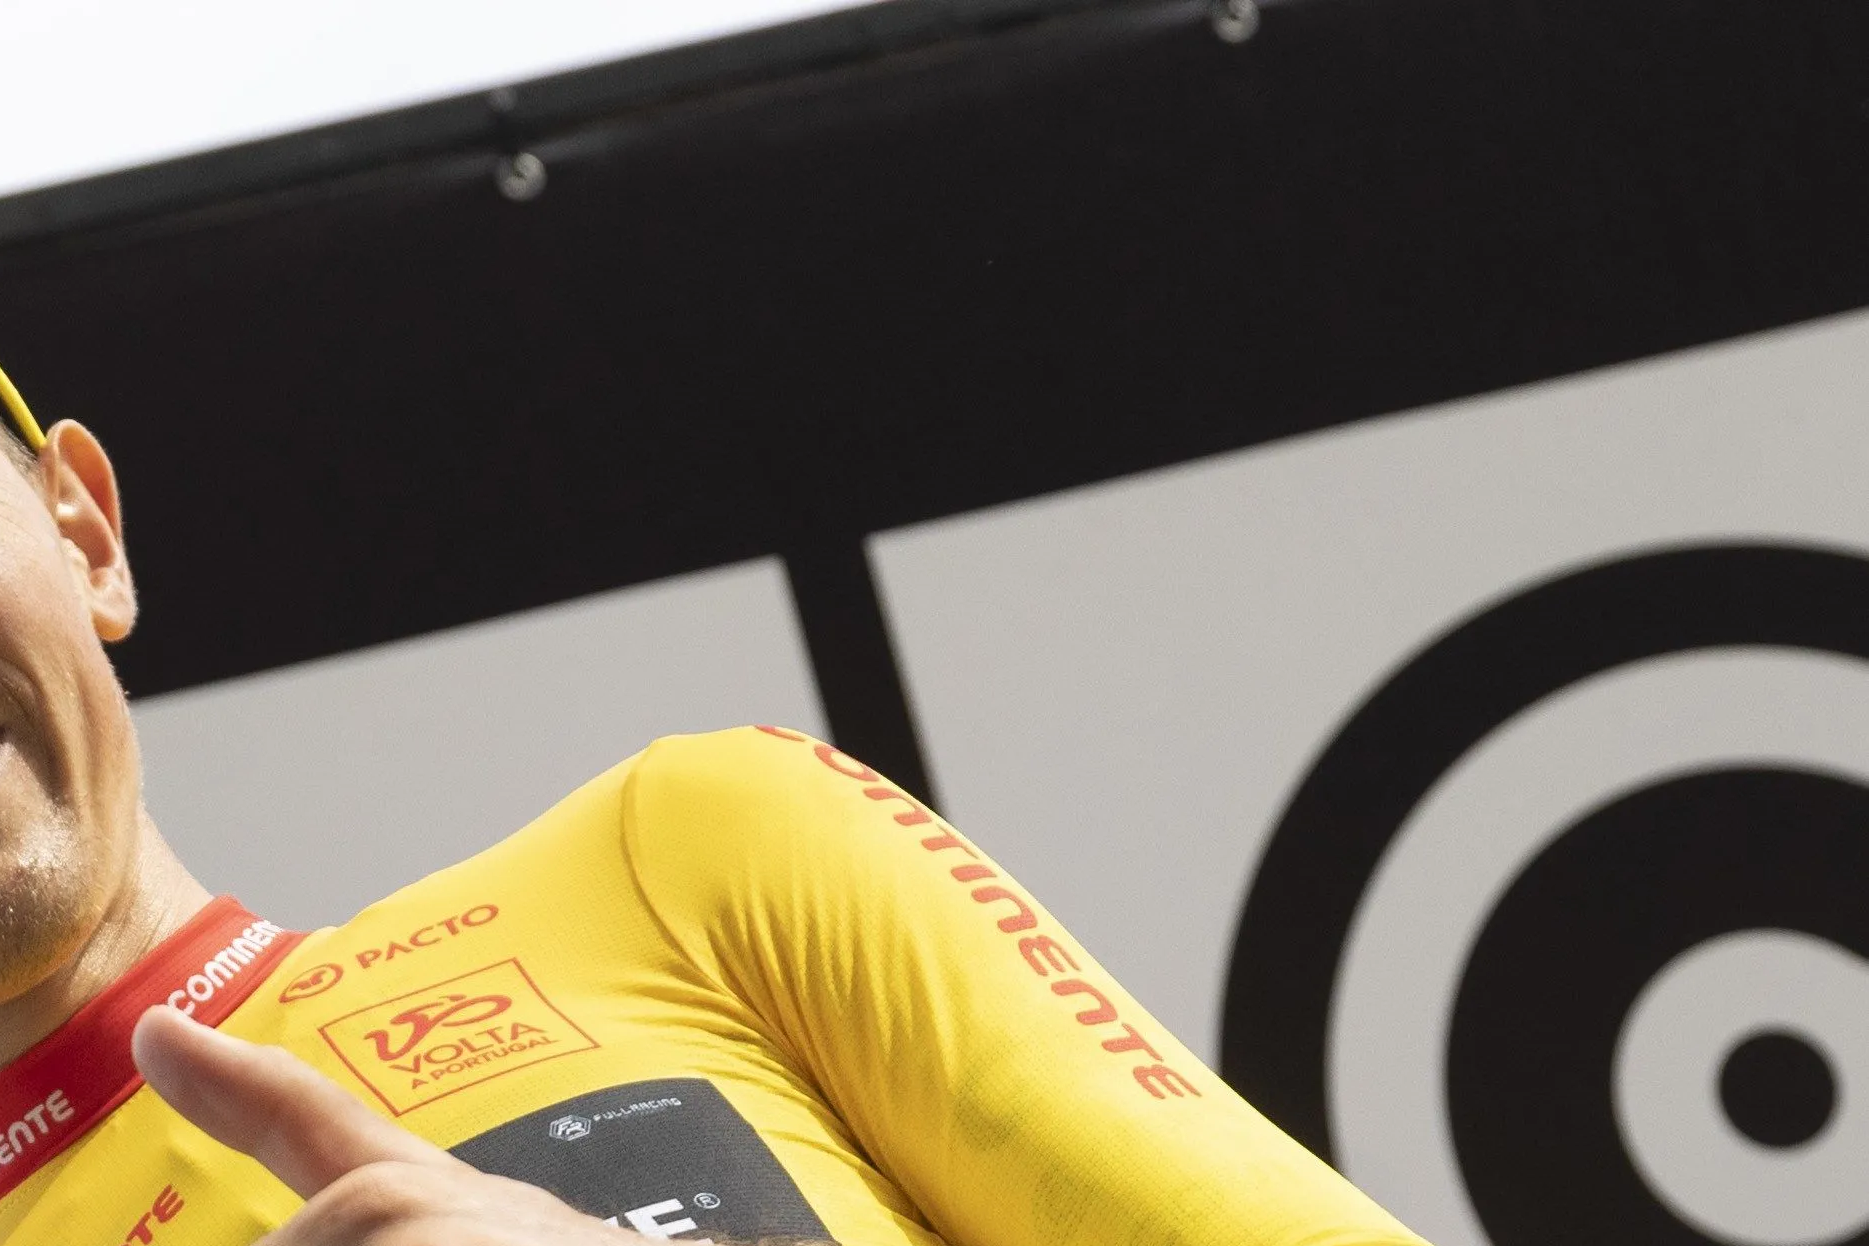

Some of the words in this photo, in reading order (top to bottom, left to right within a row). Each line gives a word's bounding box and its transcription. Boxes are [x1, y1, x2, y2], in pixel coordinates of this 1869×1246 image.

[355, 904, 499, 969] PACTO
[389, 1022, 547, 1073] VOLTA
[412, 1078, 428, 1089] A
[428, 1036, 561, 1081] PORTUGAL
